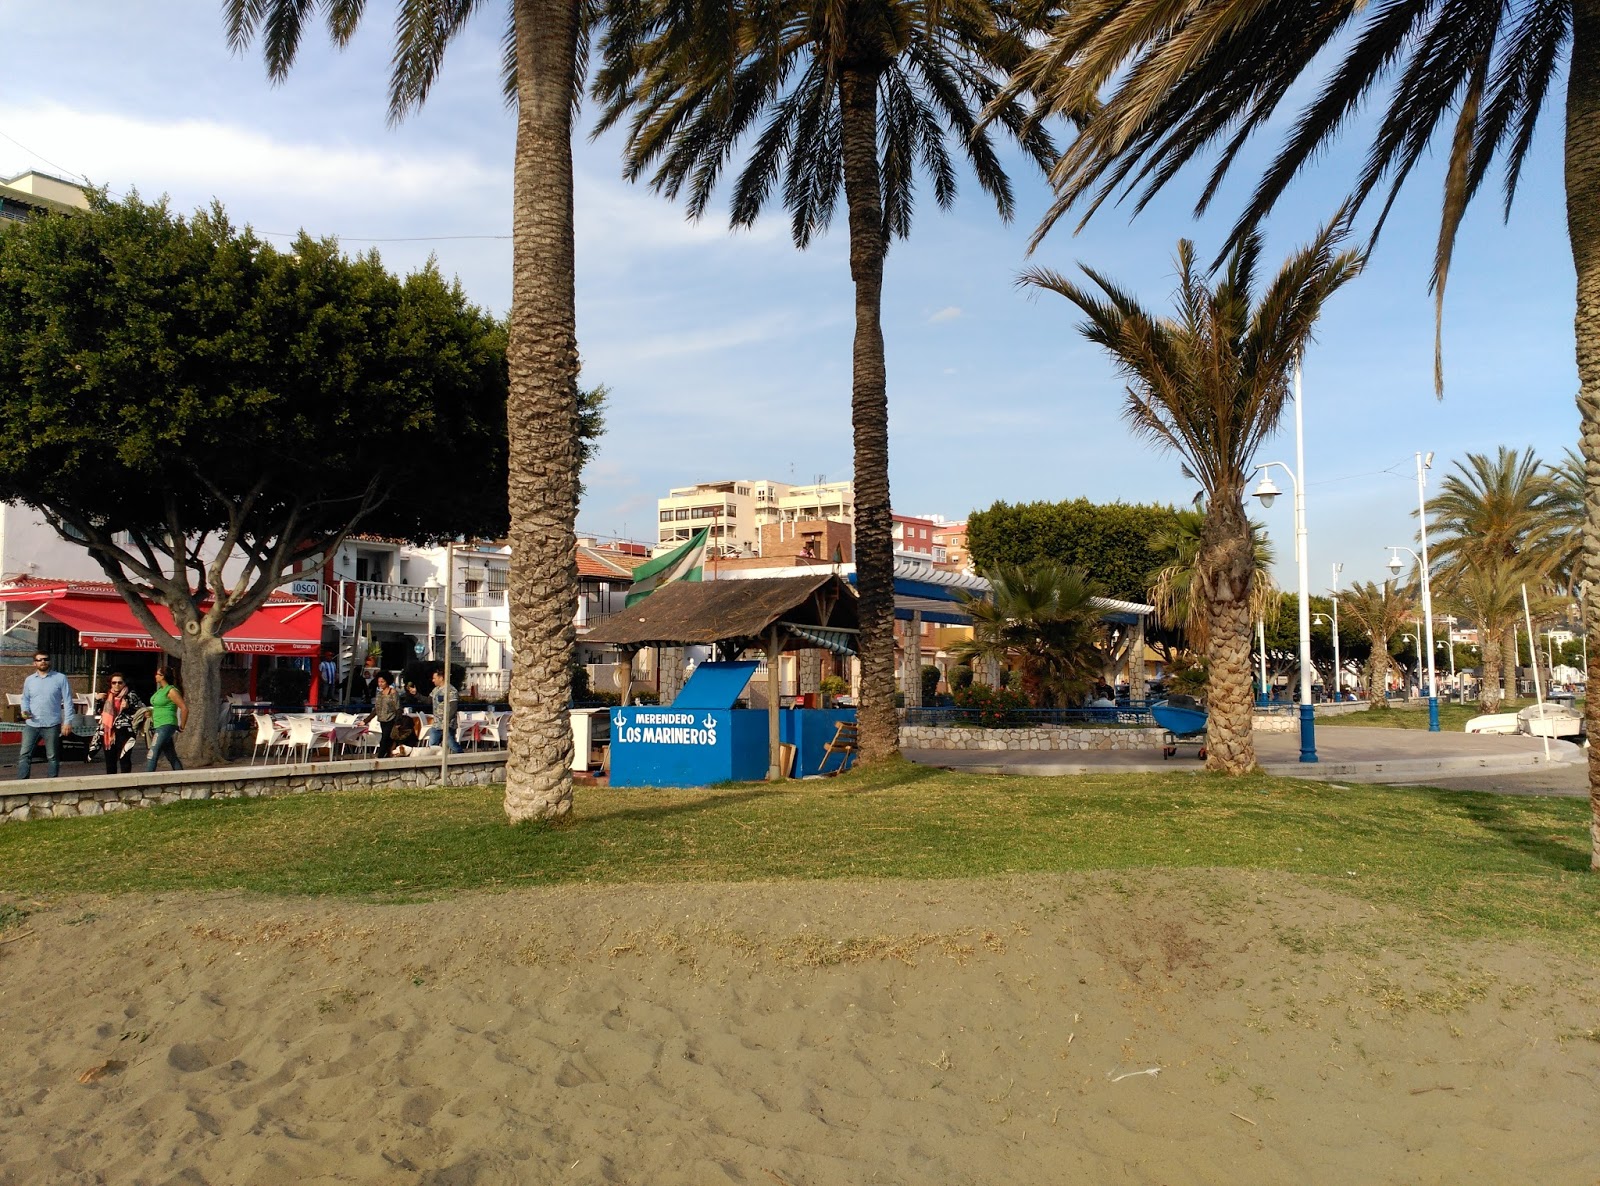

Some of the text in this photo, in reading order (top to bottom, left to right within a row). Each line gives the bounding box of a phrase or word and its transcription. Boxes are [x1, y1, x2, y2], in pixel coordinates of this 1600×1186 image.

[293, 583, 316, 593] IOSCO
[136, 639, 275, 652] MER MARINEROS
[636, 714, 694, 725] MERENDERO
[619, 727, 716, 745] LOS MARINEROS
